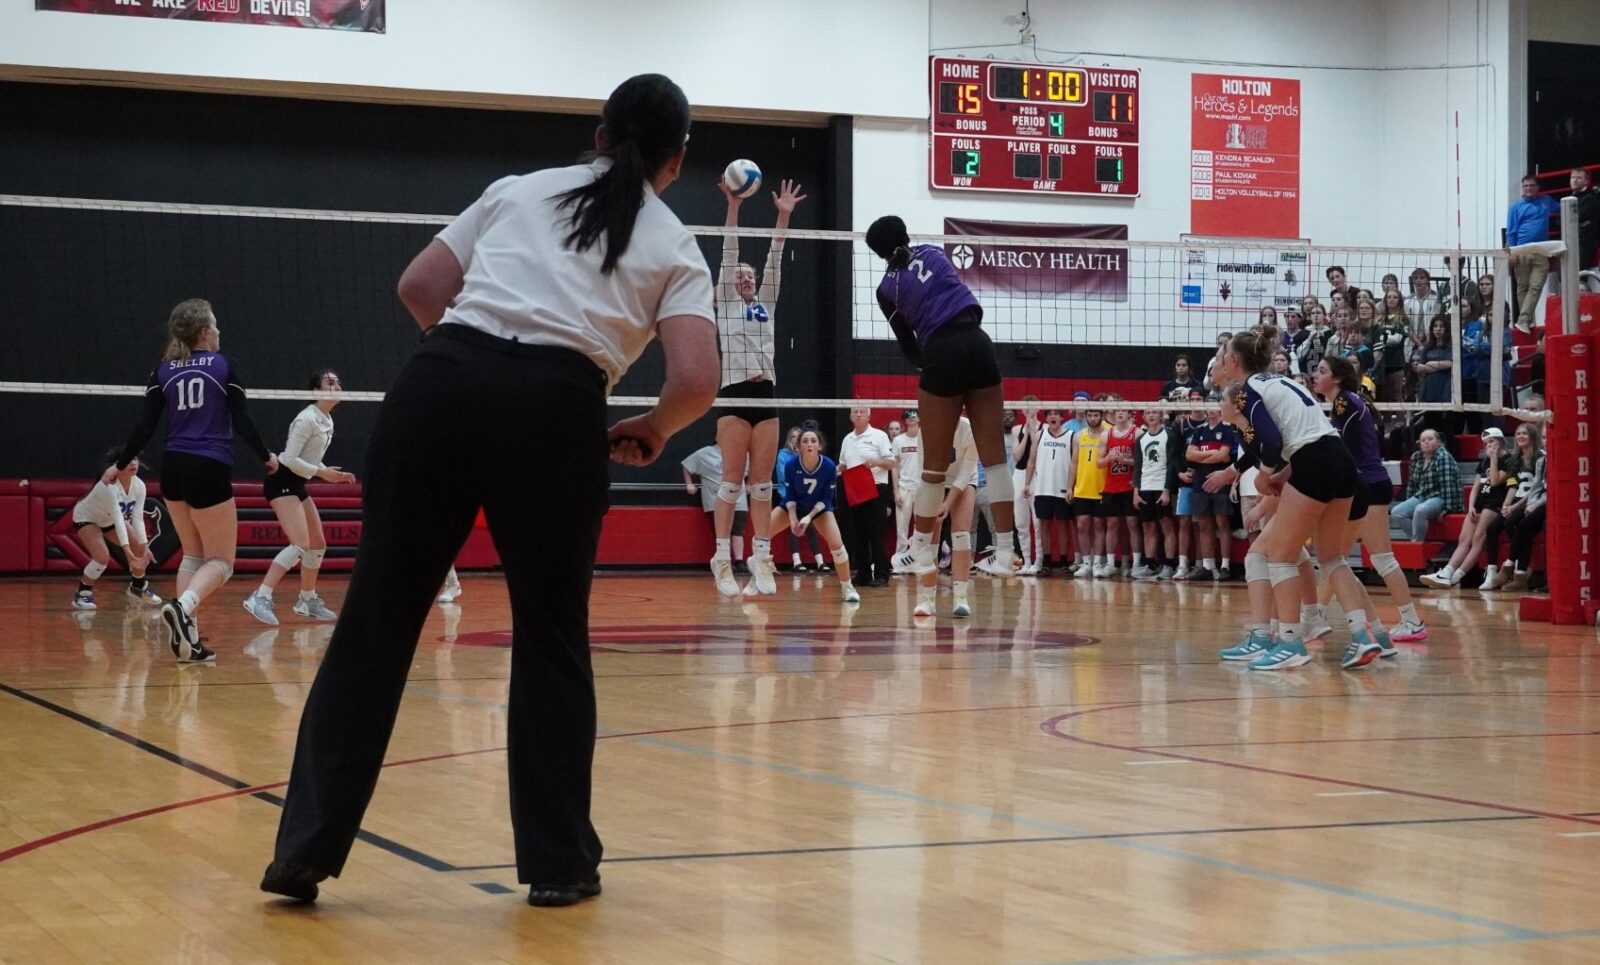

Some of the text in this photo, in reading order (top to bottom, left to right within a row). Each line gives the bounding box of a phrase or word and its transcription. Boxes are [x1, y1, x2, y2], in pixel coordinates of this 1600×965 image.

[250, 0, 311, 17] DEVILS!
[943, 63, 979, 79] HOME
[1023, 70, 1080, 101] 1:00
[1089, 72, 1137, 89] VISITOR
[1221, 79, 1271, 96] HOLTON
[958, 84, 980, 114] 15
[1019, 106, 1038, 115] POSS
[1111, 94, 1133, 122] 11
[1194, 96, 1299, 122] Heroes & Legends
[956, 119, 987, 131] BONUS
[1012, 115, 1045, 127] PERIOD
[1050, 114, 1063, 136] 4
[1088, 126, 1118, 138] BONUS
[951, 138, 980, 150] FOULS
[1007, 141, 1076, 155] PLAYER FOULS
[1095, 146, 1123, 157] FOULS
[966, 152, 979, 175] 2
[1215, 154, 1242, 162] KENDRA
[1117, 159, 1122, 181] 1
[953, 177, 972, 186] WON
[1033, 181, 1056, 190] GAME
[1101, 183, 1119, 193] WON
[1215, 188, 1237, 196] HOLTON
[1238, 189, 1272, 197] VOLLEYBALL
[1273, 190, 1281, 198] OF
[979, 250, 1121, 271] MERCY HEALTH
[908, 259, 933, 284] 2
[169, 356, 214, 370] SHELBY
[176, 377, 204, 411] 10
[1280, 380, 1315, 407] 1
[1575, 369, 1588, 442] RED
[1044, 441, 1067, 449] UCONN
[1052, 449, 1056, 460] 1
[1088, 450, 1092, 461] 1
[803, 478, 817, 495] 7
[1577, 456, 1591, 606] DEVILS
